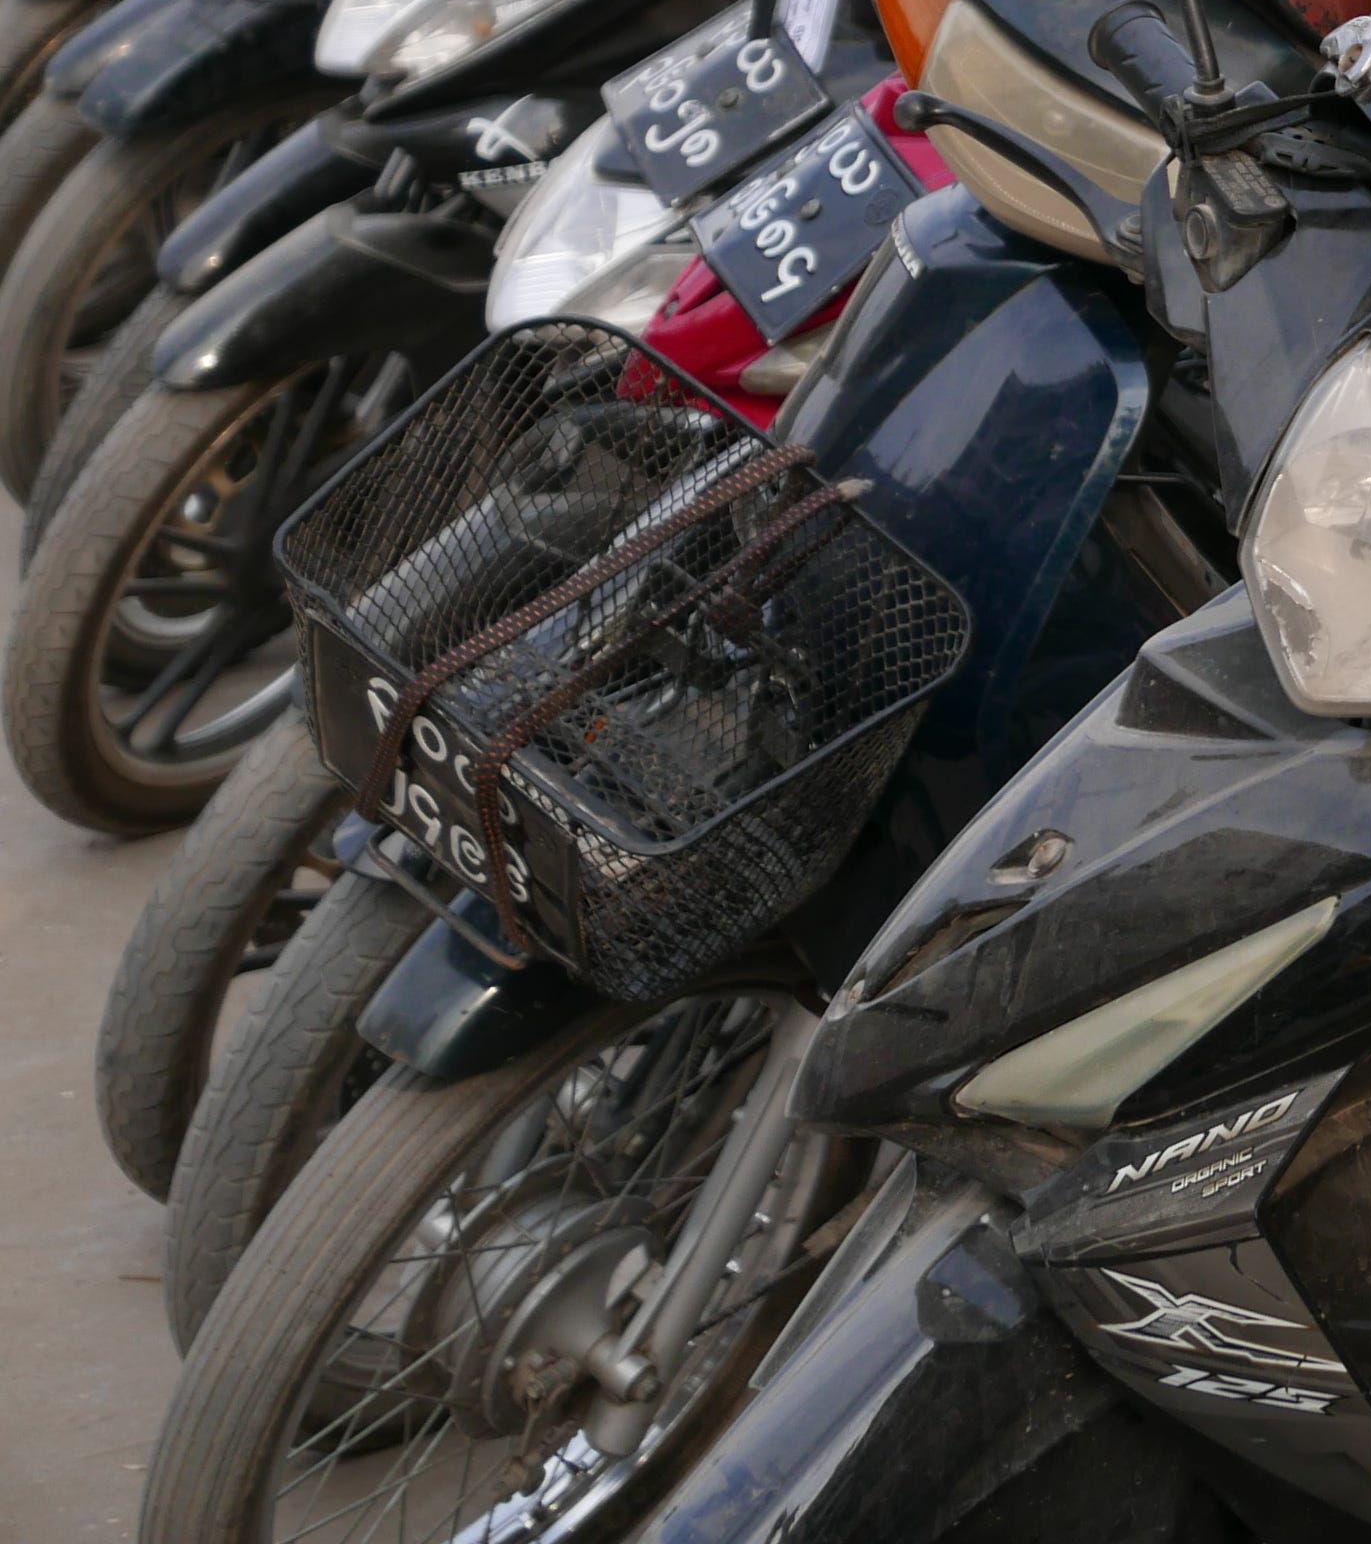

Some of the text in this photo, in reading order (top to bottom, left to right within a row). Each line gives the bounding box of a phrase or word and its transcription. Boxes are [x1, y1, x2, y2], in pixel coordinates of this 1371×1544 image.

[457, 159, 551, 190] KENB
[1106, 1090, 1300, 1195] NANO
[1170, 1146, 1254, 1194] ORGANIC
[1201, 1159, 1268, 1199] SPORT
